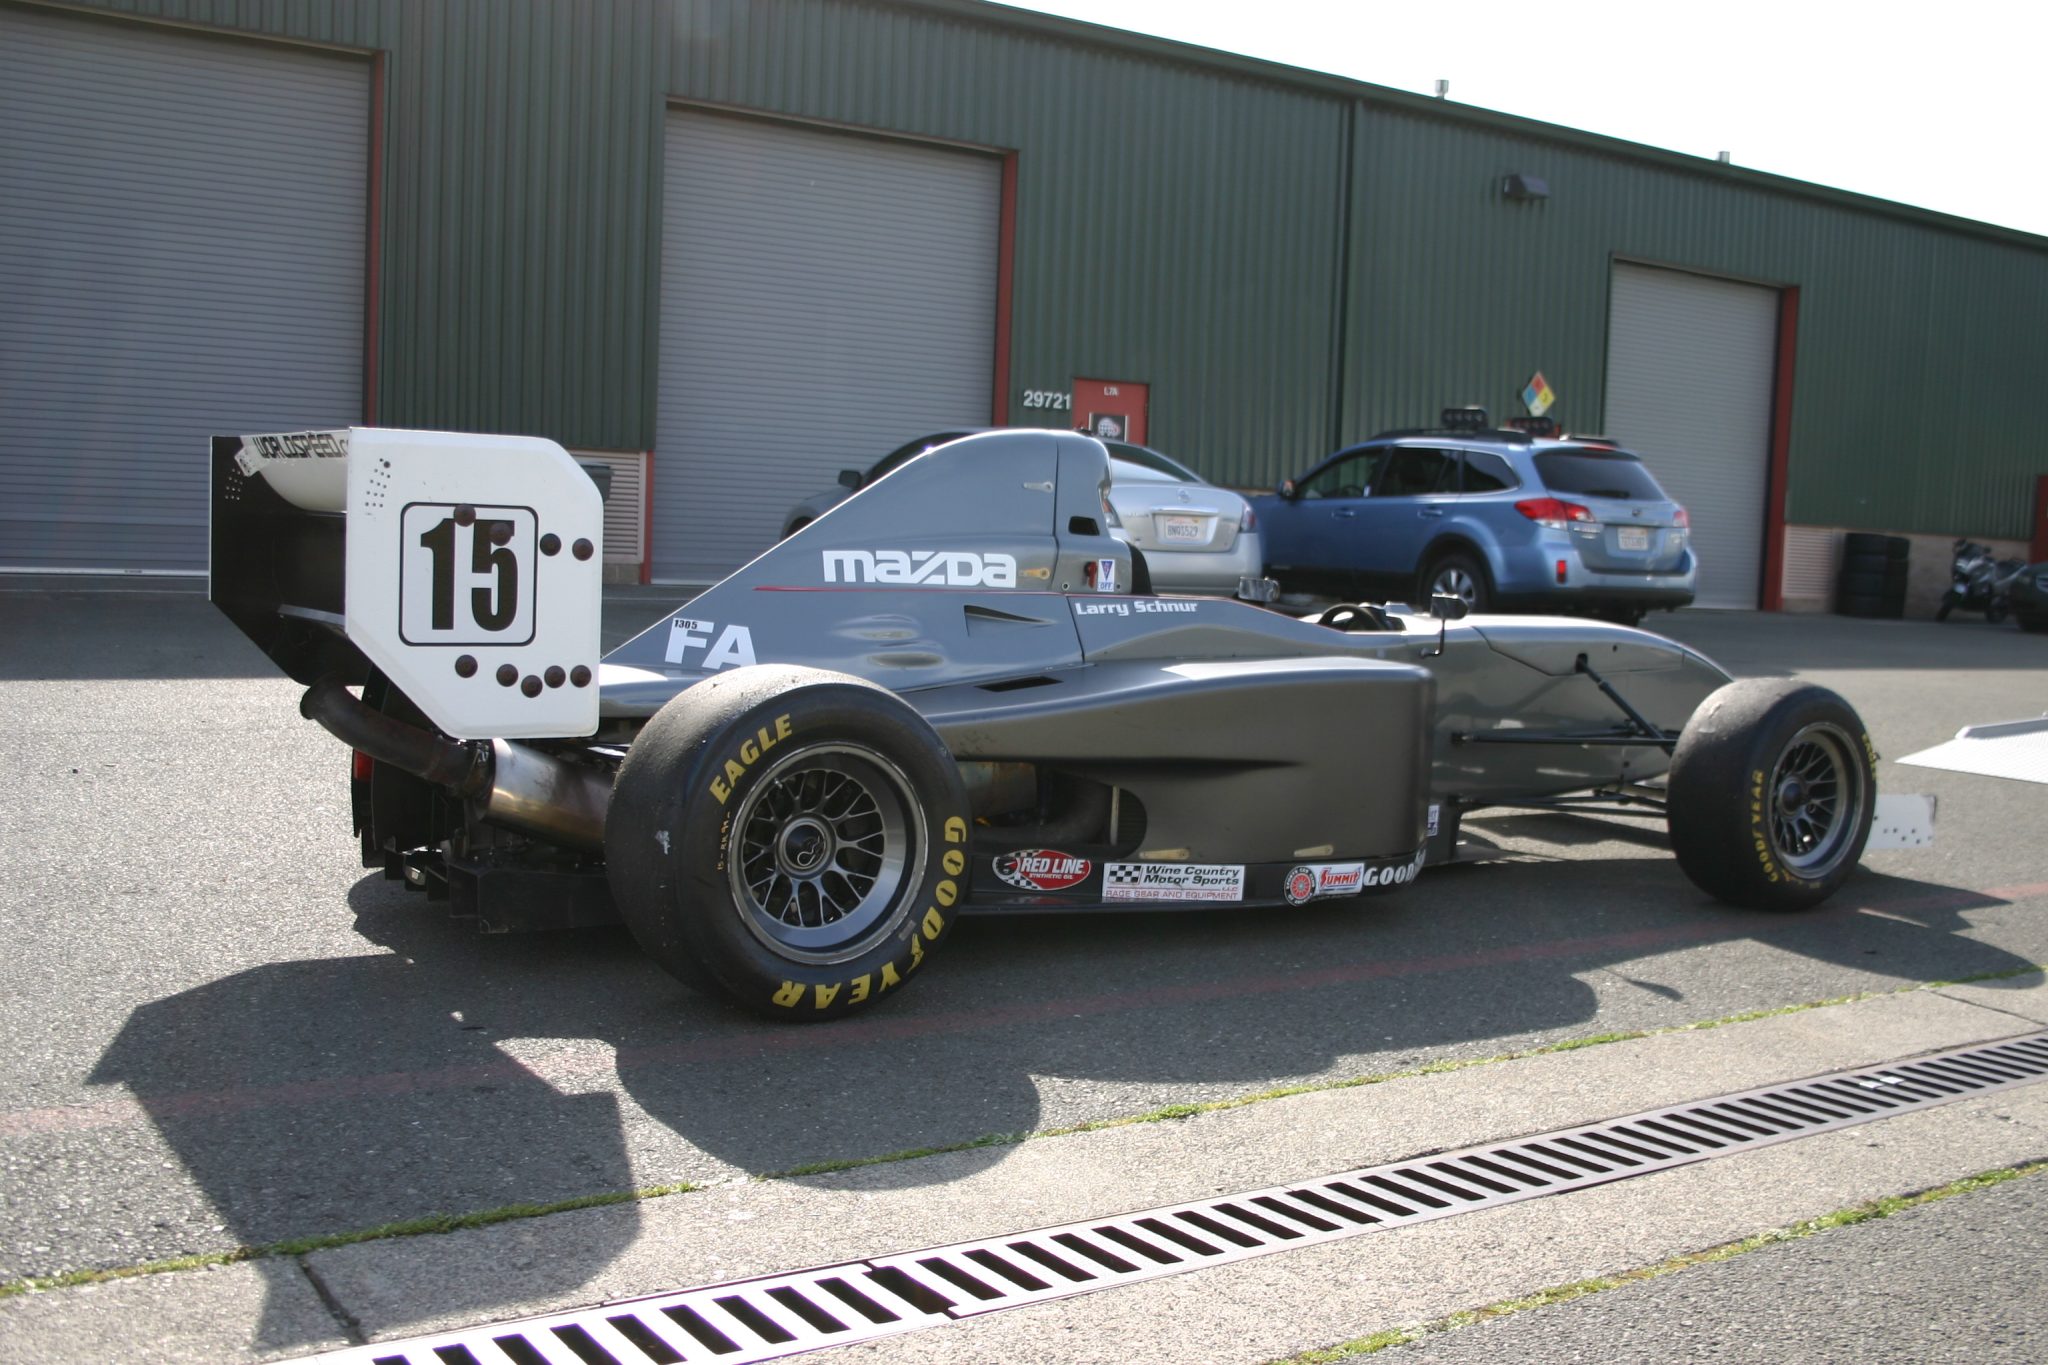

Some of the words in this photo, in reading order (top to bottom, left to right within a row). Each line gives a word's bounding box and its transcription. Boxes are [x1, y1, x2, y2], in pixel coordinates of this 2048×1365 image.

[1022, 389, 1072, 410] 29721
[420, 517, 518, 632] 15
[1099, 582, 1113, 590] OFF
[1074, 602, 1130, 616] Larry
[1133, 600, 1199, 613] Schnur
[674, 619, 698, 630] 1305
[664, 617, 757, 670] FA
[709, 713, 792, 805] EAGLE
[1020, 857, 1051, 873] RED
[1051, 858, 1086, 874] LINE
[1145, 865, 1182, 875] Wine
[1184, 866, 1240, 877] Country
[1143, 875, 1189, 884] Motor
[1191, 876, 1239, 886] Sports
[1320, 867, 1360, 888] SUMMIT
[1105, 890, 1132, 898] RACE
[1185, 892, 1238, 900] EQUIPMENT
[771, 815, 967, 1010] GOODYEAR
